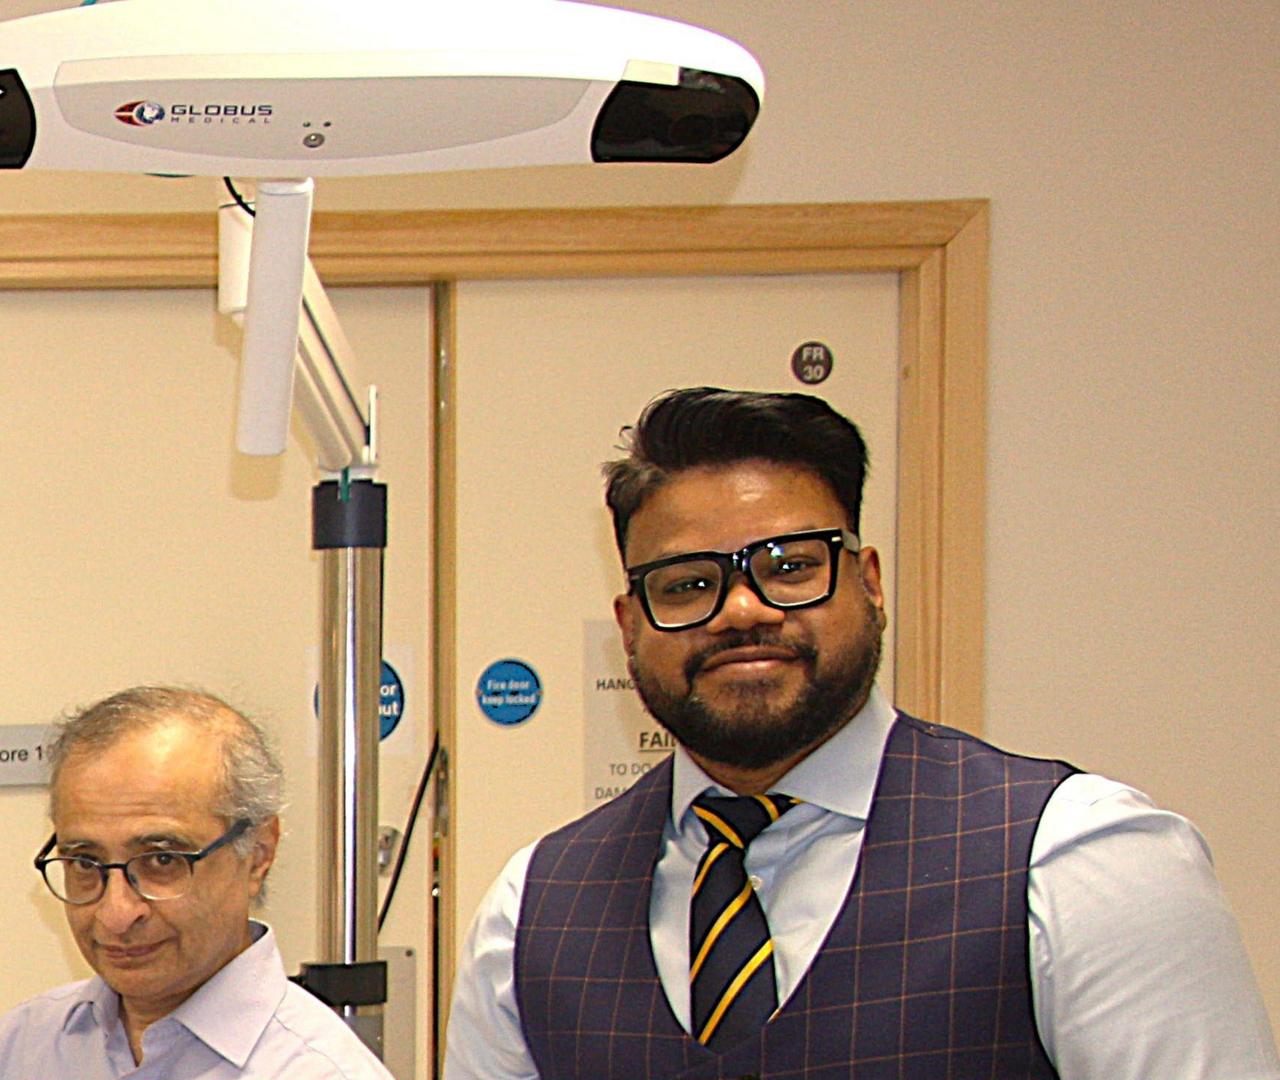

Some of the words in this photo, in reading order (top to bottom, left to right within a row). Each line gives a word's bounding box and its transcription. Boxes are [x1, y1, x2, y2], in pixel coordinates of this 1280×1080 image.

[171, 104, 272, 116] GLOBUS
[802, 346, 824, 361] FR
[803, 365, 824, 380] 30
[487, 680, 506, 691] Fire
[508, 680, 529, 689] door
[482, 696, 503, 706] keep
[505, 694, 536, 704] locked
[609, 763, 627, 776] TO
